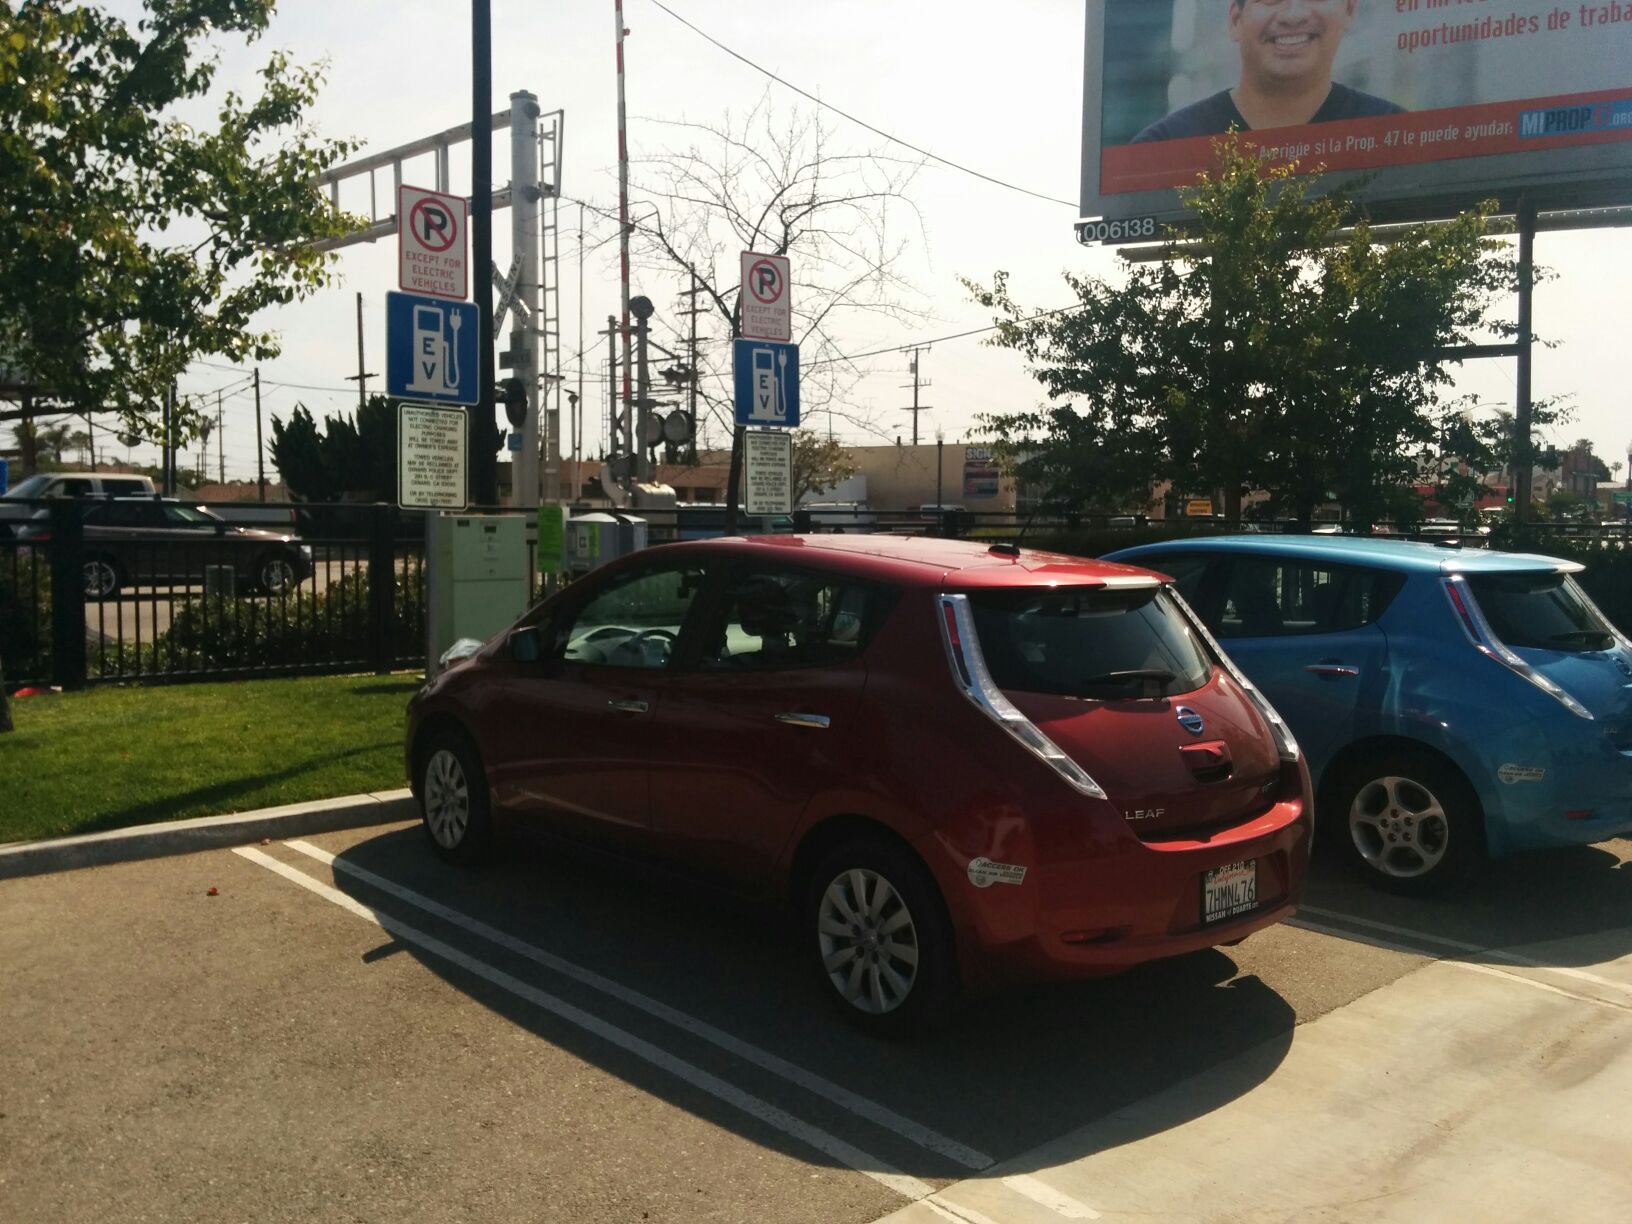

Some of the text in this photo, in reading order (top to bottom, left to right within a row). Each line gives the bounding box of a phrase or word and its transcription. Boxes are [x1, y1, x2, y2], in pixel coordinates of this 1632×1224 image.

[1397, 13, 1539, 53] oportunidades
[1547, 7, 1570, 31] de
[1315, 138, 1325, 154] si
[1329, 138, 1341, 152] la
[1346, 135, 1378, 151] Prop.
[1384, 130, 1400, 146] 47
[1403, 130, 1414, 144] le
[1420, 125, 1458, 146] puede
[1464, 120, 1513, 141] ayudar:
[1084, 218, 1154, 241] 006138
[406, 251, 460, 268] EXCEPT FOR
[412, 264, 454, 280] ELECTRIC
[412, 277, 455, 292] VEHICLES
[746, 305, 786, 316] EXCEPT FOR
[751, 316, 782, 325] ELECTRIC
[752, 326, 782, 336] VEHICLES
[1125, 808, 1165, 820] LEAF
[1206, 878, 1256, 914] 7HMN476
[1206, 910, 1226, 922] NISSAN
[1232, 903, 1251, 914] DUARTE
